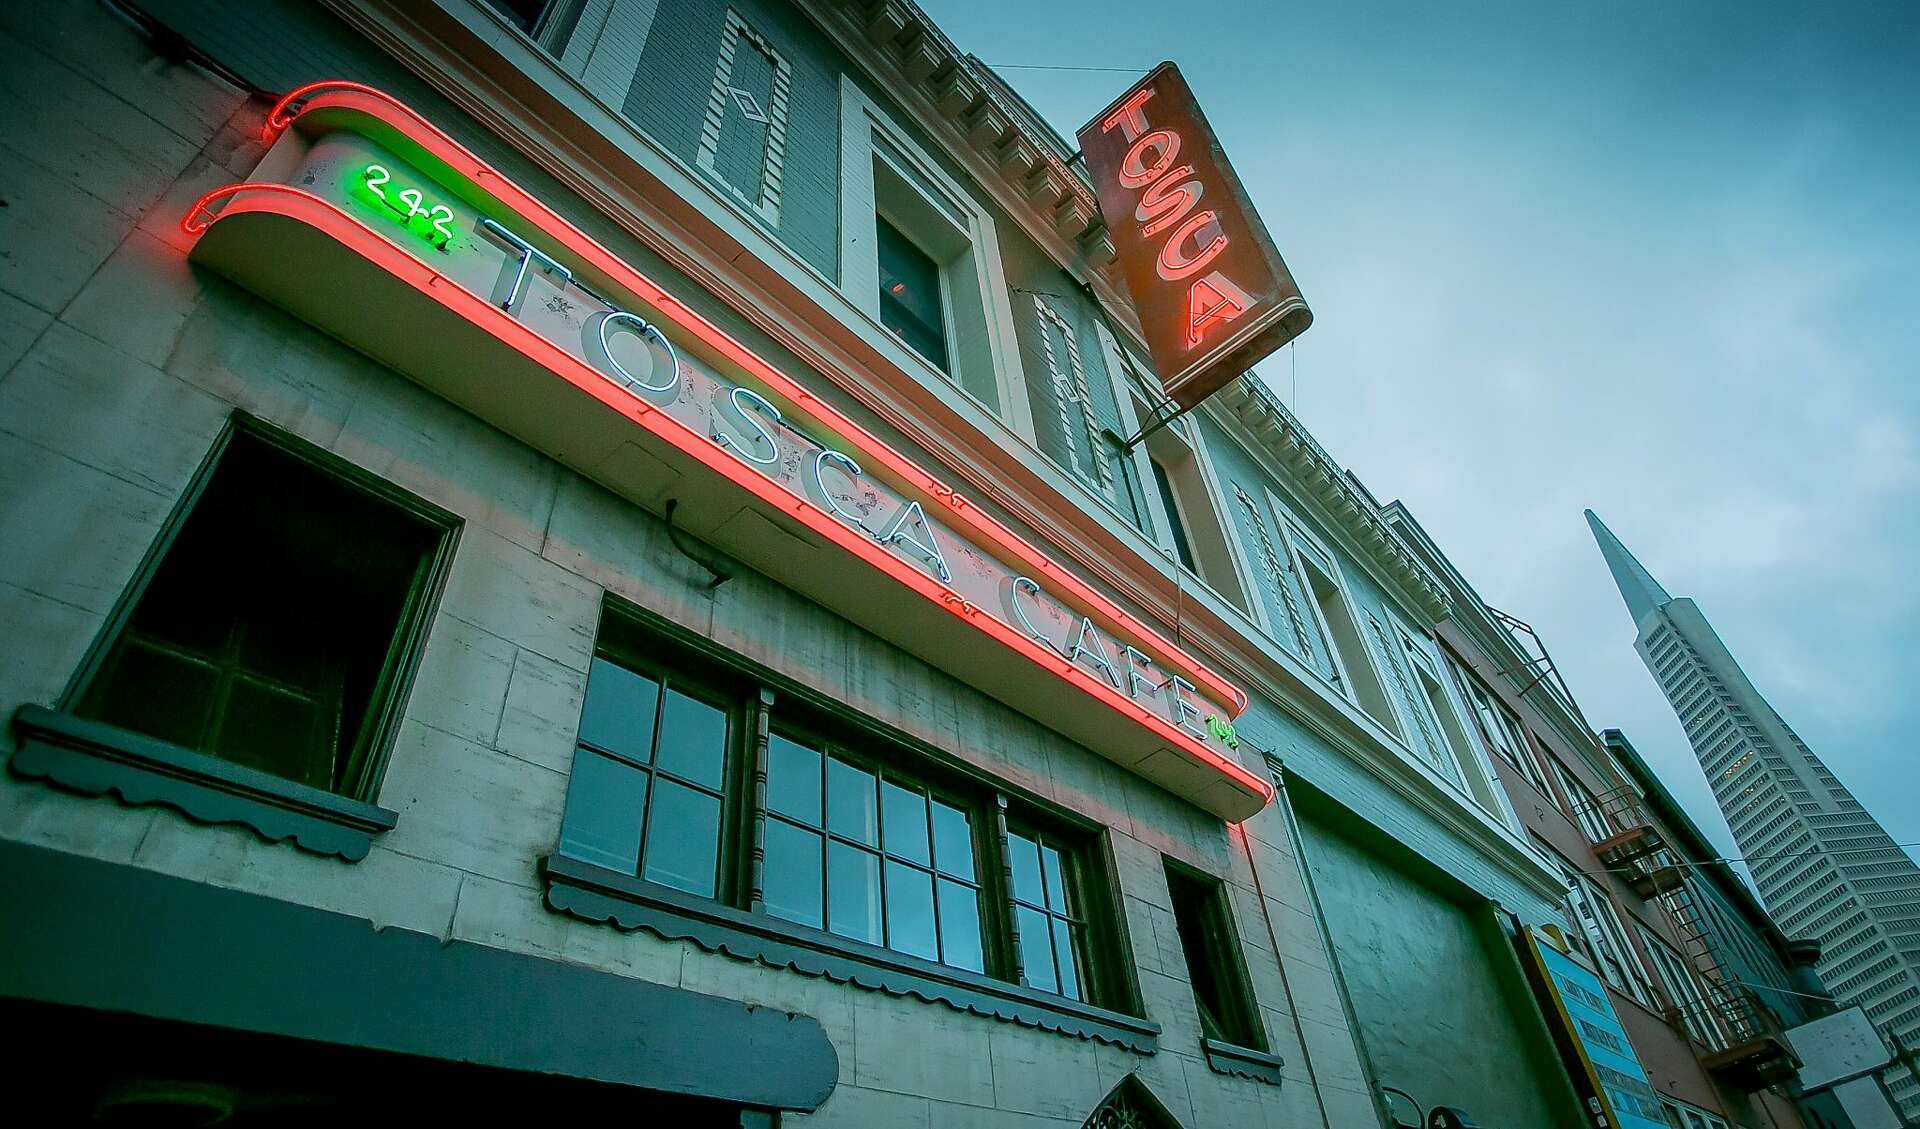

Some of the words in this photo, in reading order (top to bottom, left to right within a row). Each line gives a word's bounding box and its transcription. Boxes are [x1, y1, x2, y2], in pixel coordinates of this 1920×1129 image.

[1102, 87, 1257, 350] TOSCA
[366, 165, 454, 240] 242
[477, 217, 953, 584] TOSCA
[1007, 575, 1208, 741] CAFE
